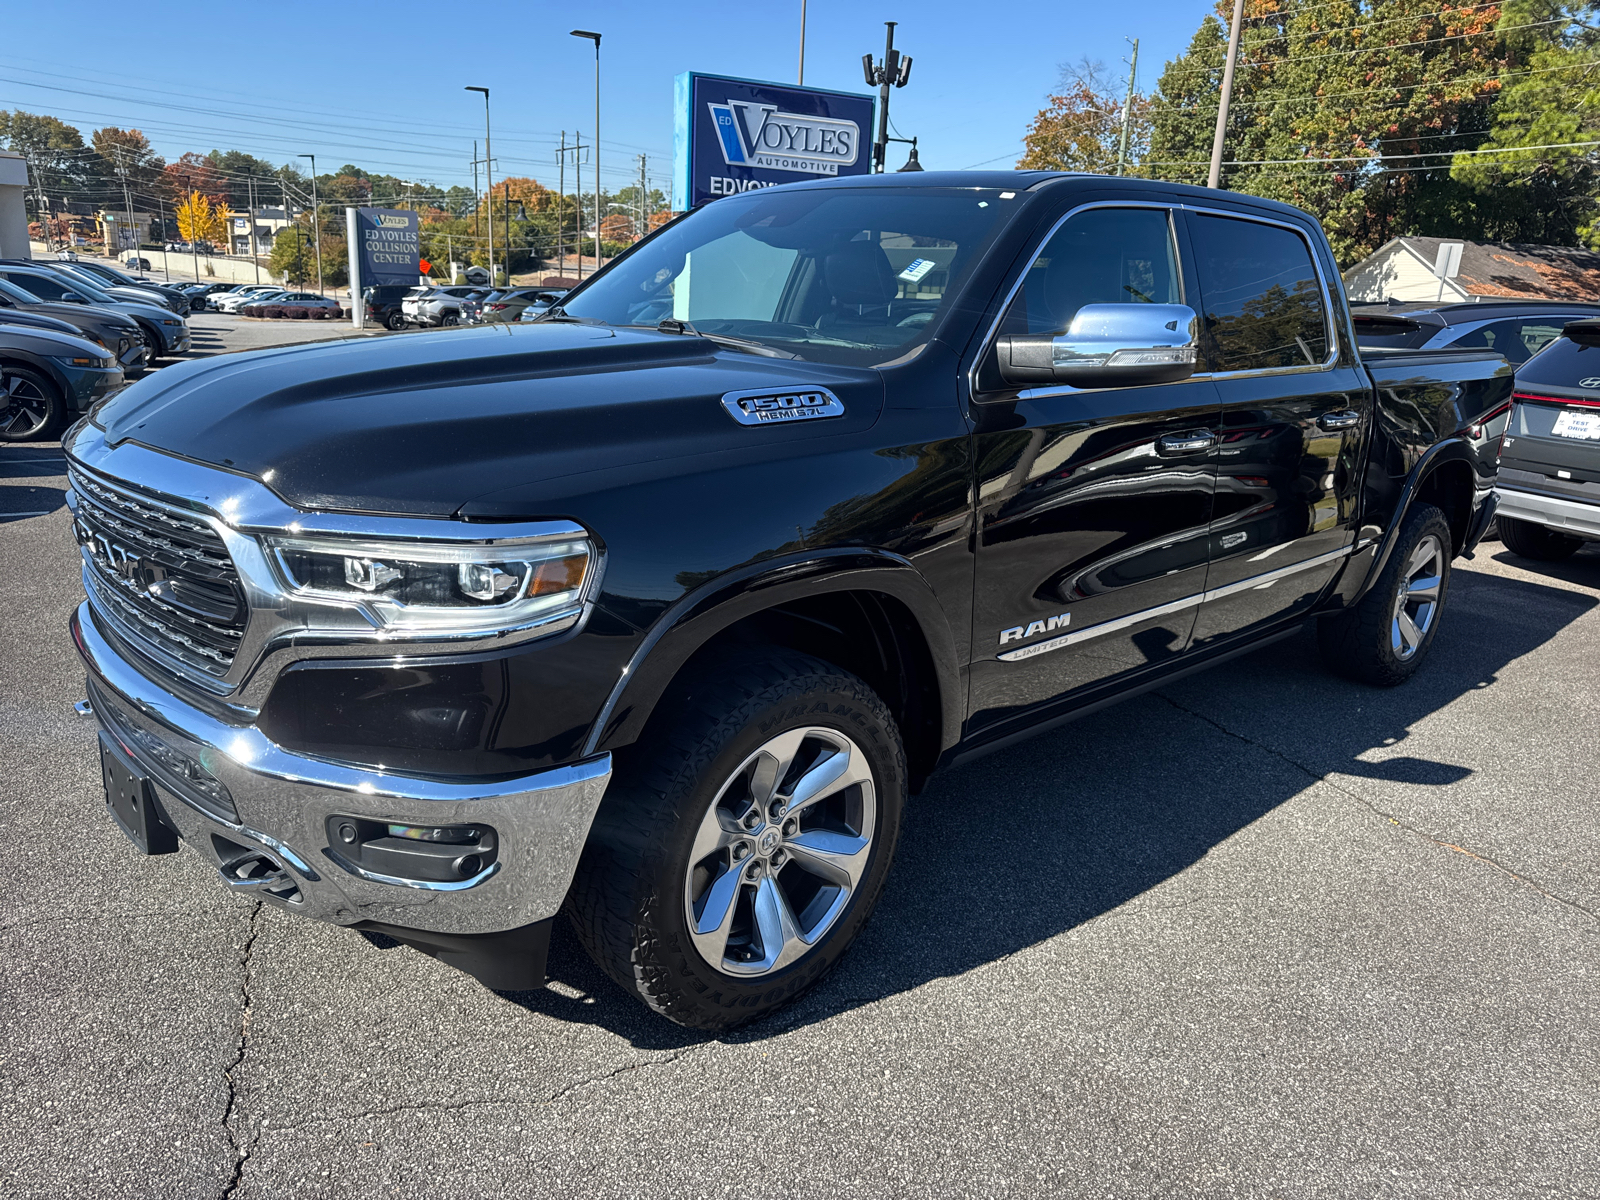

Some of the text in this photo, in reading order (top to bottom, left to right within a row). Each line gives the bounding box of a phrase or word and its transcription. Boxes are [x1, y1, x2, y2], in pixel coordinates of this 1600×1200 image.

[718, 103, 851, 158] ED VOYLES
[756, 156, 837, 173] AUTOMOTIVE
[365, 229, 417, 242] ED VOYLES
[366, 241, 417, 253] COLLISION
[373, 252, 411, 264] CENTER
[740, 393, 824, 413] 1500
[758, 407, 825, 421] HEMI 5.7L
[999, 612, 1071, 645] RAM
[1013, 637, 1069, 660] LIMITED
[757, 700, 897, 783] WRANGLER
